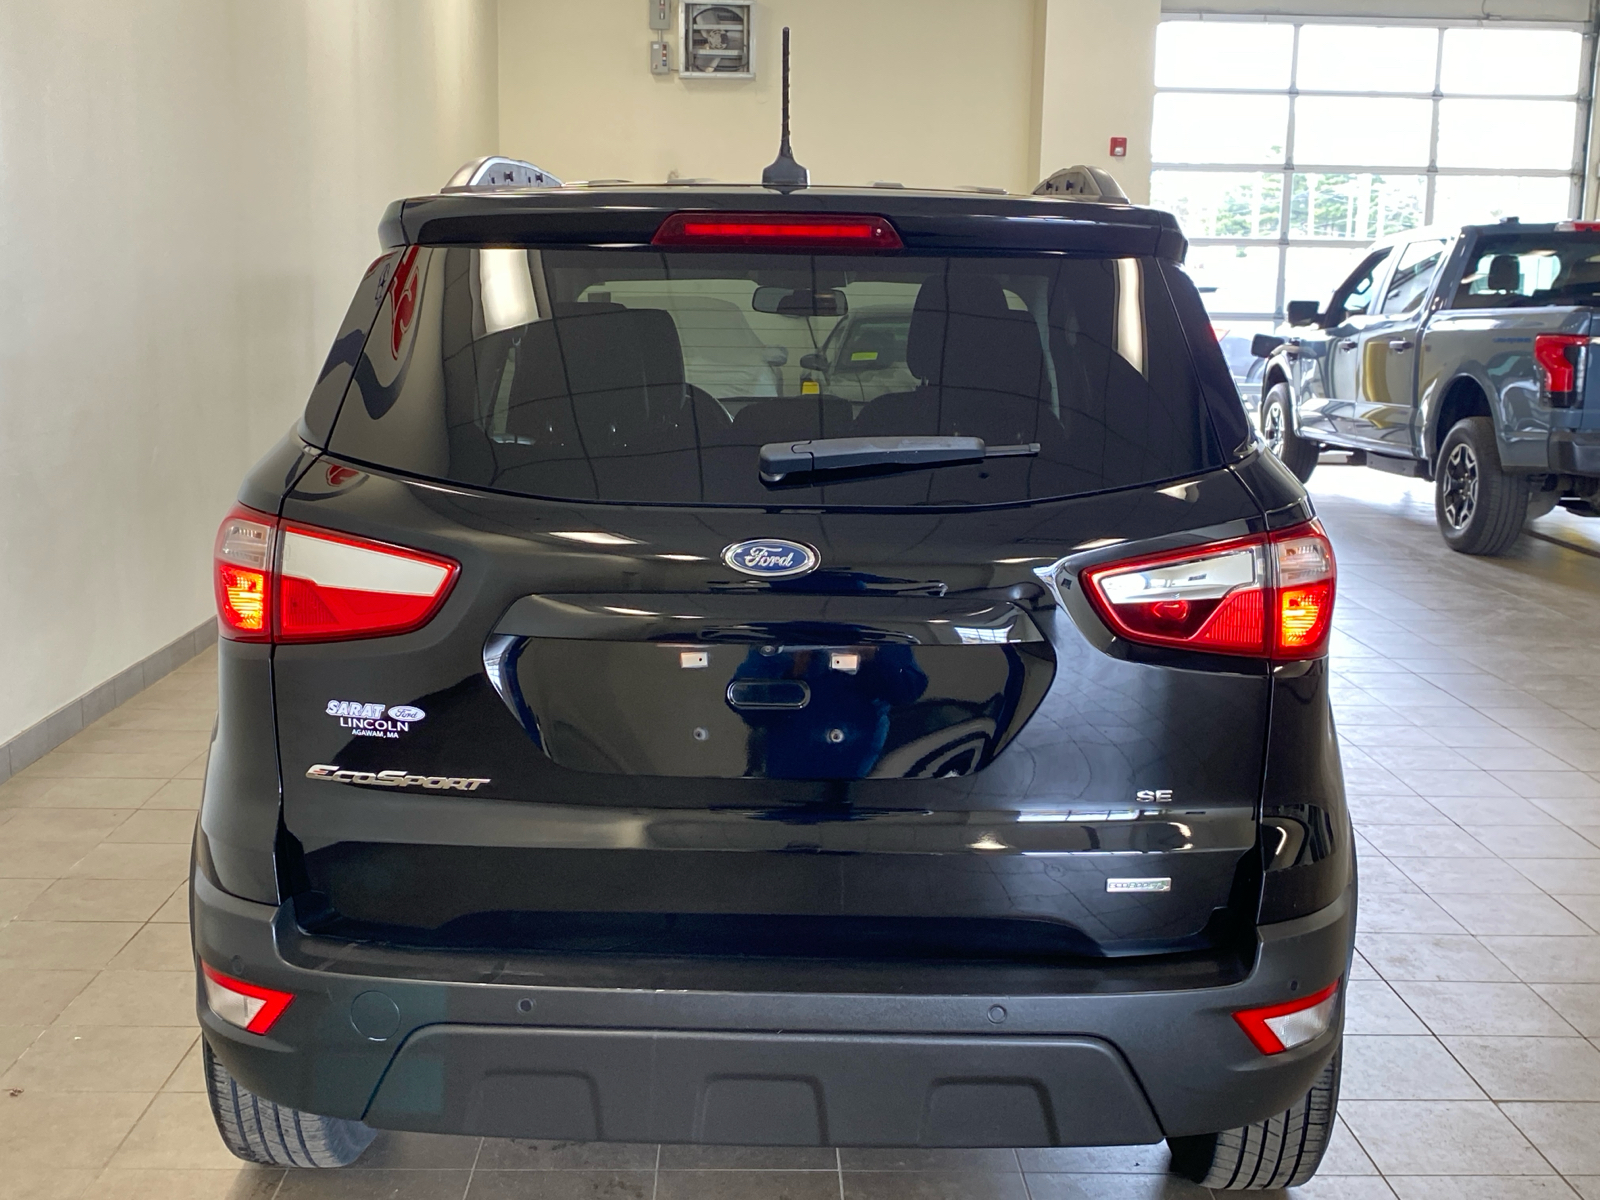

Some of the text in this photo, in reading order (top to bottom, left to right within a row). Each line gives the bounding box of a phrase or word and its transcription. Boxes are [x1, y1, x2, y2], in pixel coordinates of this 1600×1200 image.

[744, 546, 795, 568] Ford
[326, 700, 386, 720] SARAT
[340, 717, 410, 732] LINCOLN
[351, 728, 399, 739] AGAWAM, MA
[1136, 789, 1173, 802] SE
